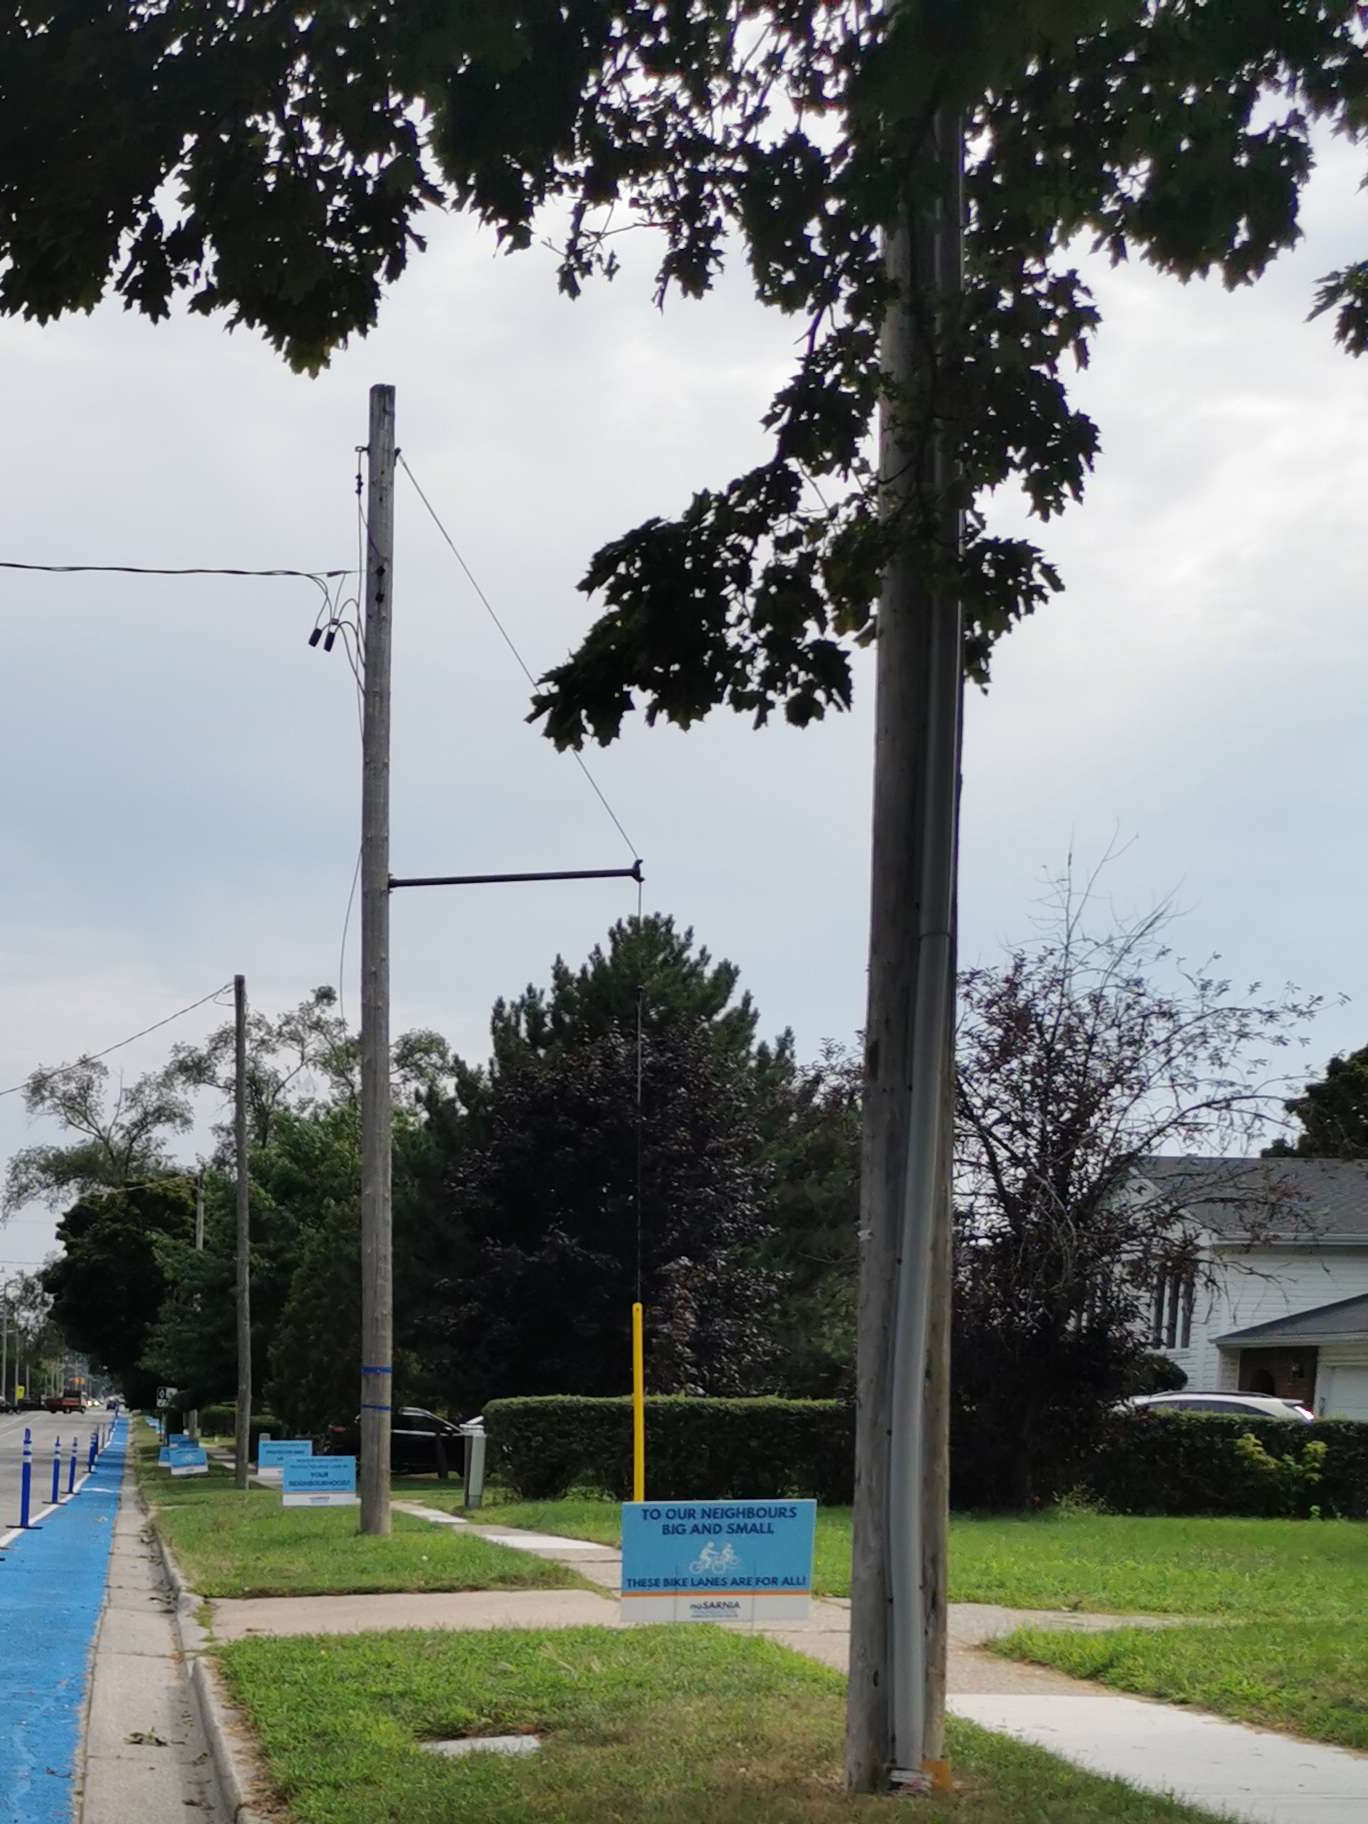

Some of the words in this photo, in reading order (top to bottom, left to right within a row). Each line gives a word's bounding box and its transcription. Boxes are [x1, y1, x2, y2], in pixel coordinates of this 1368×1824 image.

[641, 1508, 662, 1521] TO
[665, 1507, 697, 1521] OUR
[700, 1506, 798, 1521] NEIGHBOURS
[661, 1523, 687, 1536] BIG
[689, 1522, 723, 1536] AND
[725, 1522, 775, 1535] SMALL
[626, 1577, 661, 1588] THESE
[663, 1577, 688, 1588] BIKE
[690, 1576, 728, 1587] LANES
[730, 1576, 753, 1587] ARE
[755, 1576, 779, 1587] FOR
[781, 1575, 806, 1586] ALL!
